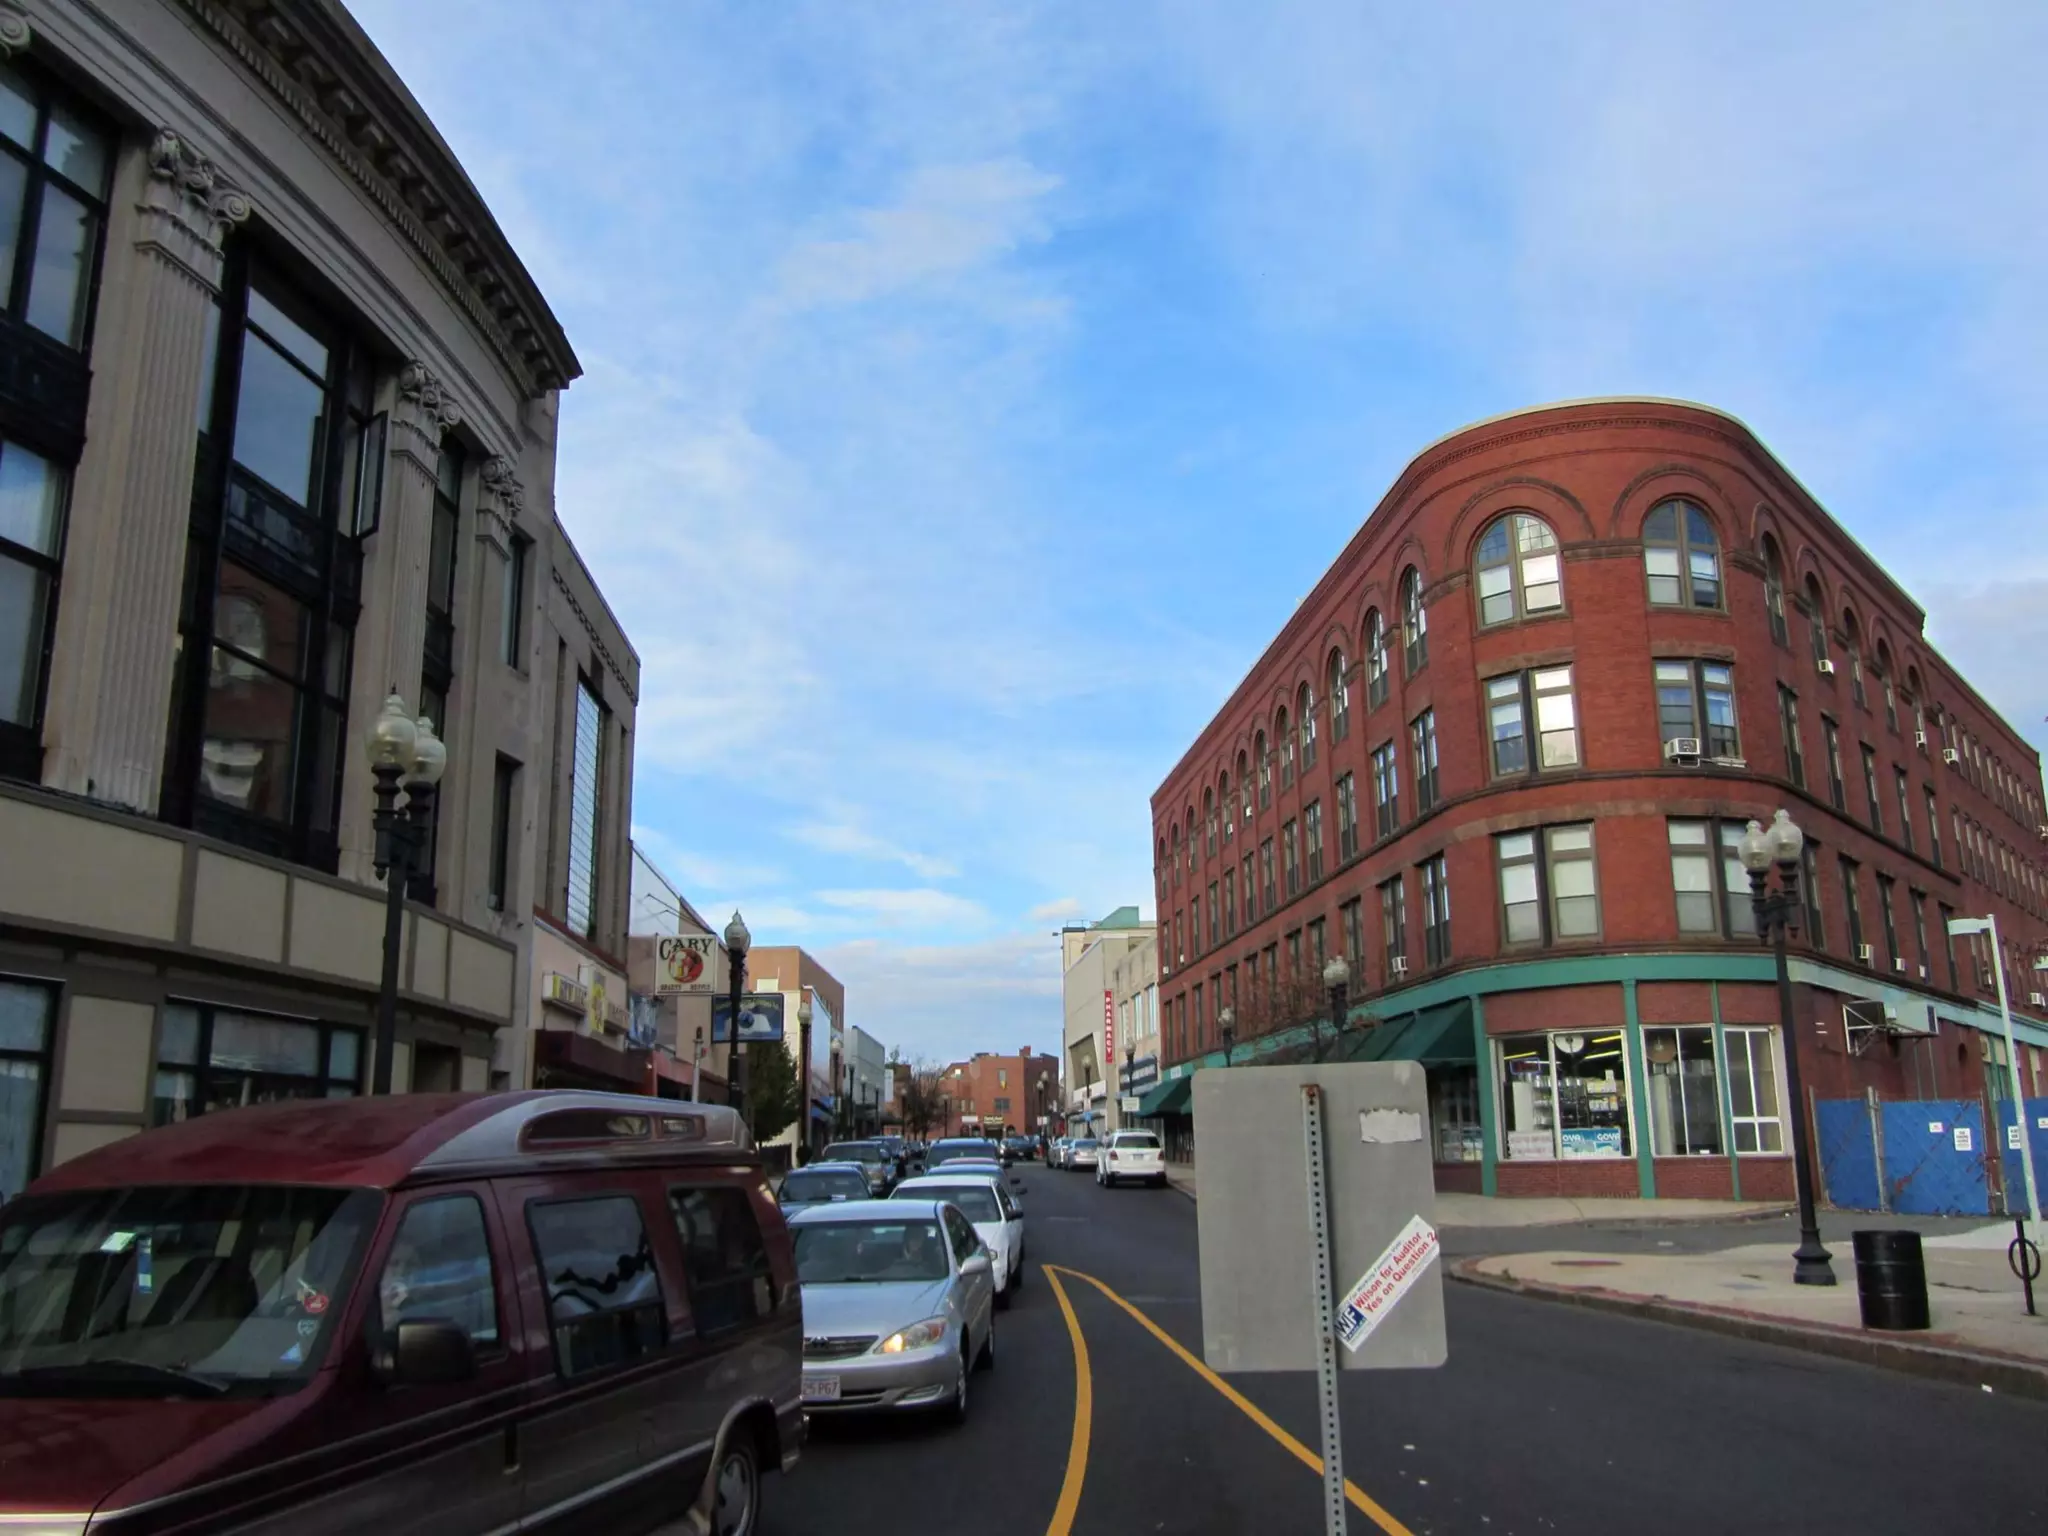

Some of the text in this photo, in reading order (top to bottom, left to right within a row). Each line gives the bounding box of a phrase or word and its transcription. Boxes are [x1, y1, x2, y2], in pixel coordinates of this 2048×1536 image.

[660, 938, 713, 960] CARY
[1354, 1279, 1383, 1309] Wilson
[1380, 1265, 1394, 1280] for
[1392, 1231, 1422, 1266] Auditor
[1364, 1297, 1384, 1313] Yes
[1382, 1281, 1395, 1296] on
[1392, 1241, 1429, 1282] Question
